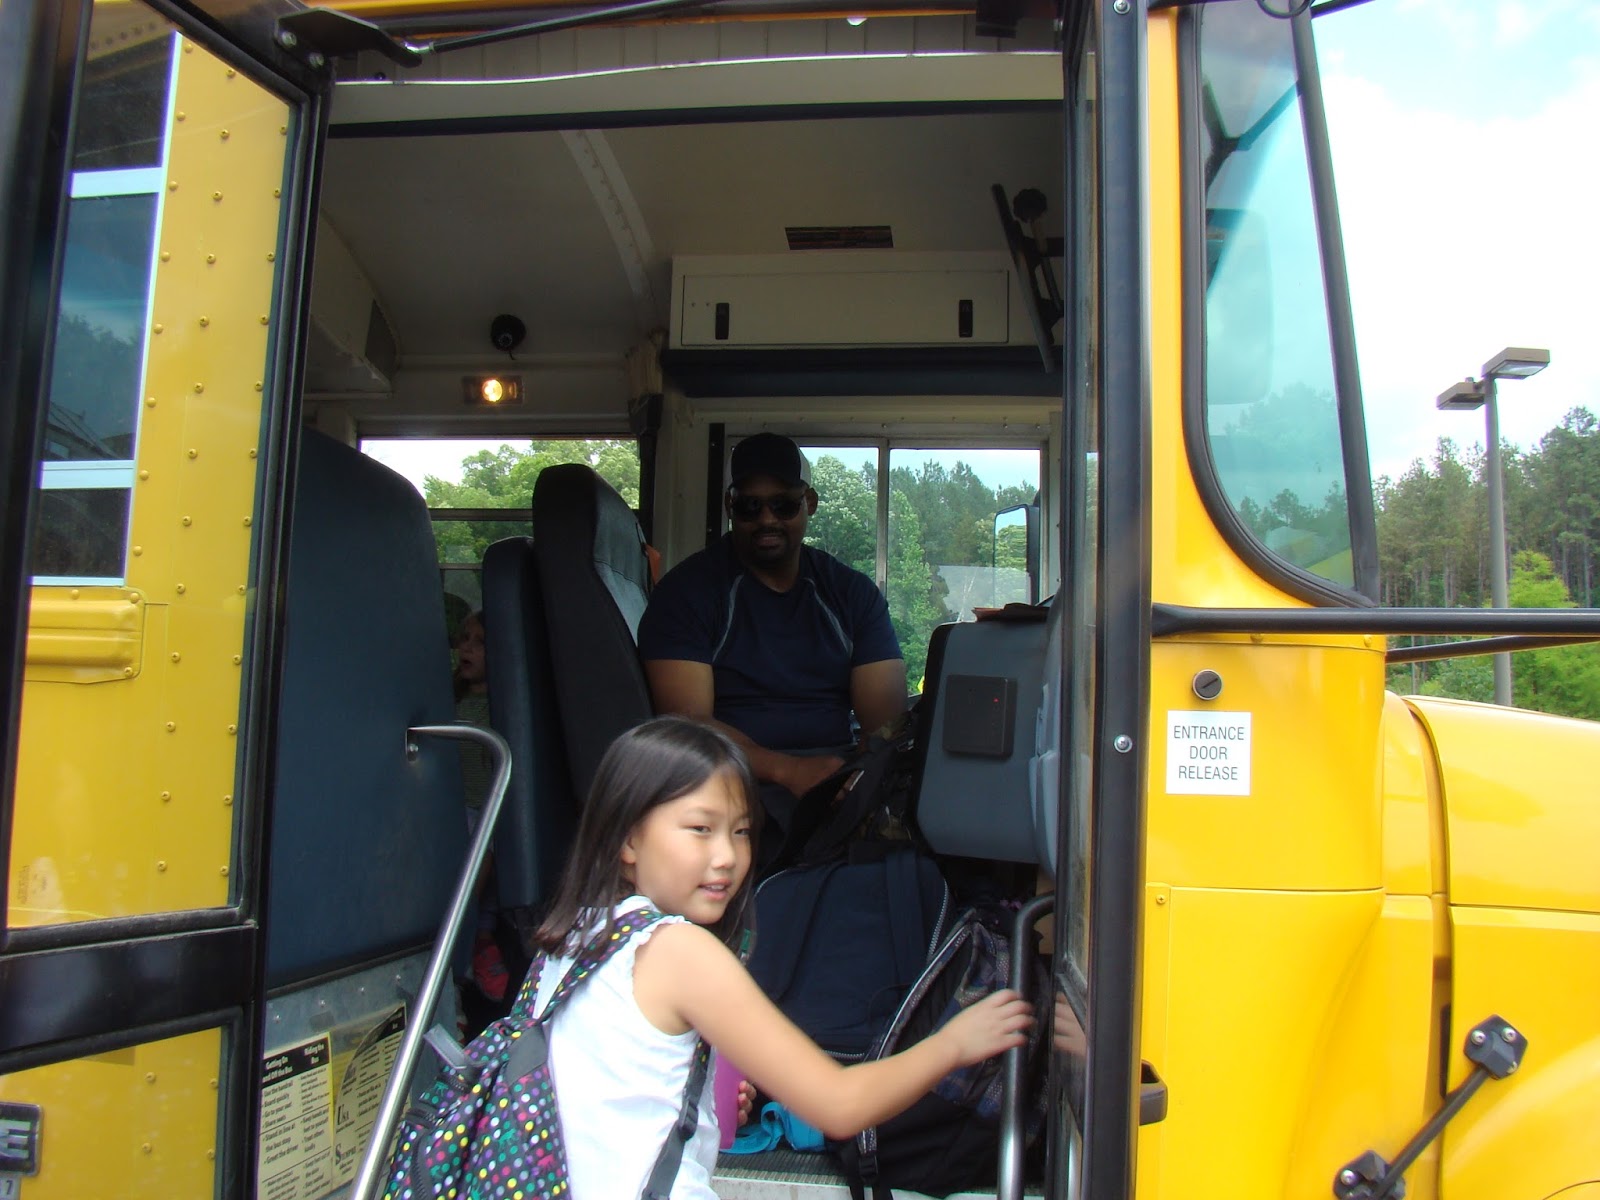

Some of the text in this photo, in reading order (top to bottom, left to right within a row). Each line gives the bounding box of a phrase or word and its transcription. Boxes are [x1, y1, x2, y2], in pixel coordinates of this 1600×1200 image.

[1173, 725, 1245, 740] ENTRANCE
[1189, 745, 1228, 760] DOOR
[1178, 765, 1238, 780] RELEASE
[266, 1058, 282, 1070] Getting
